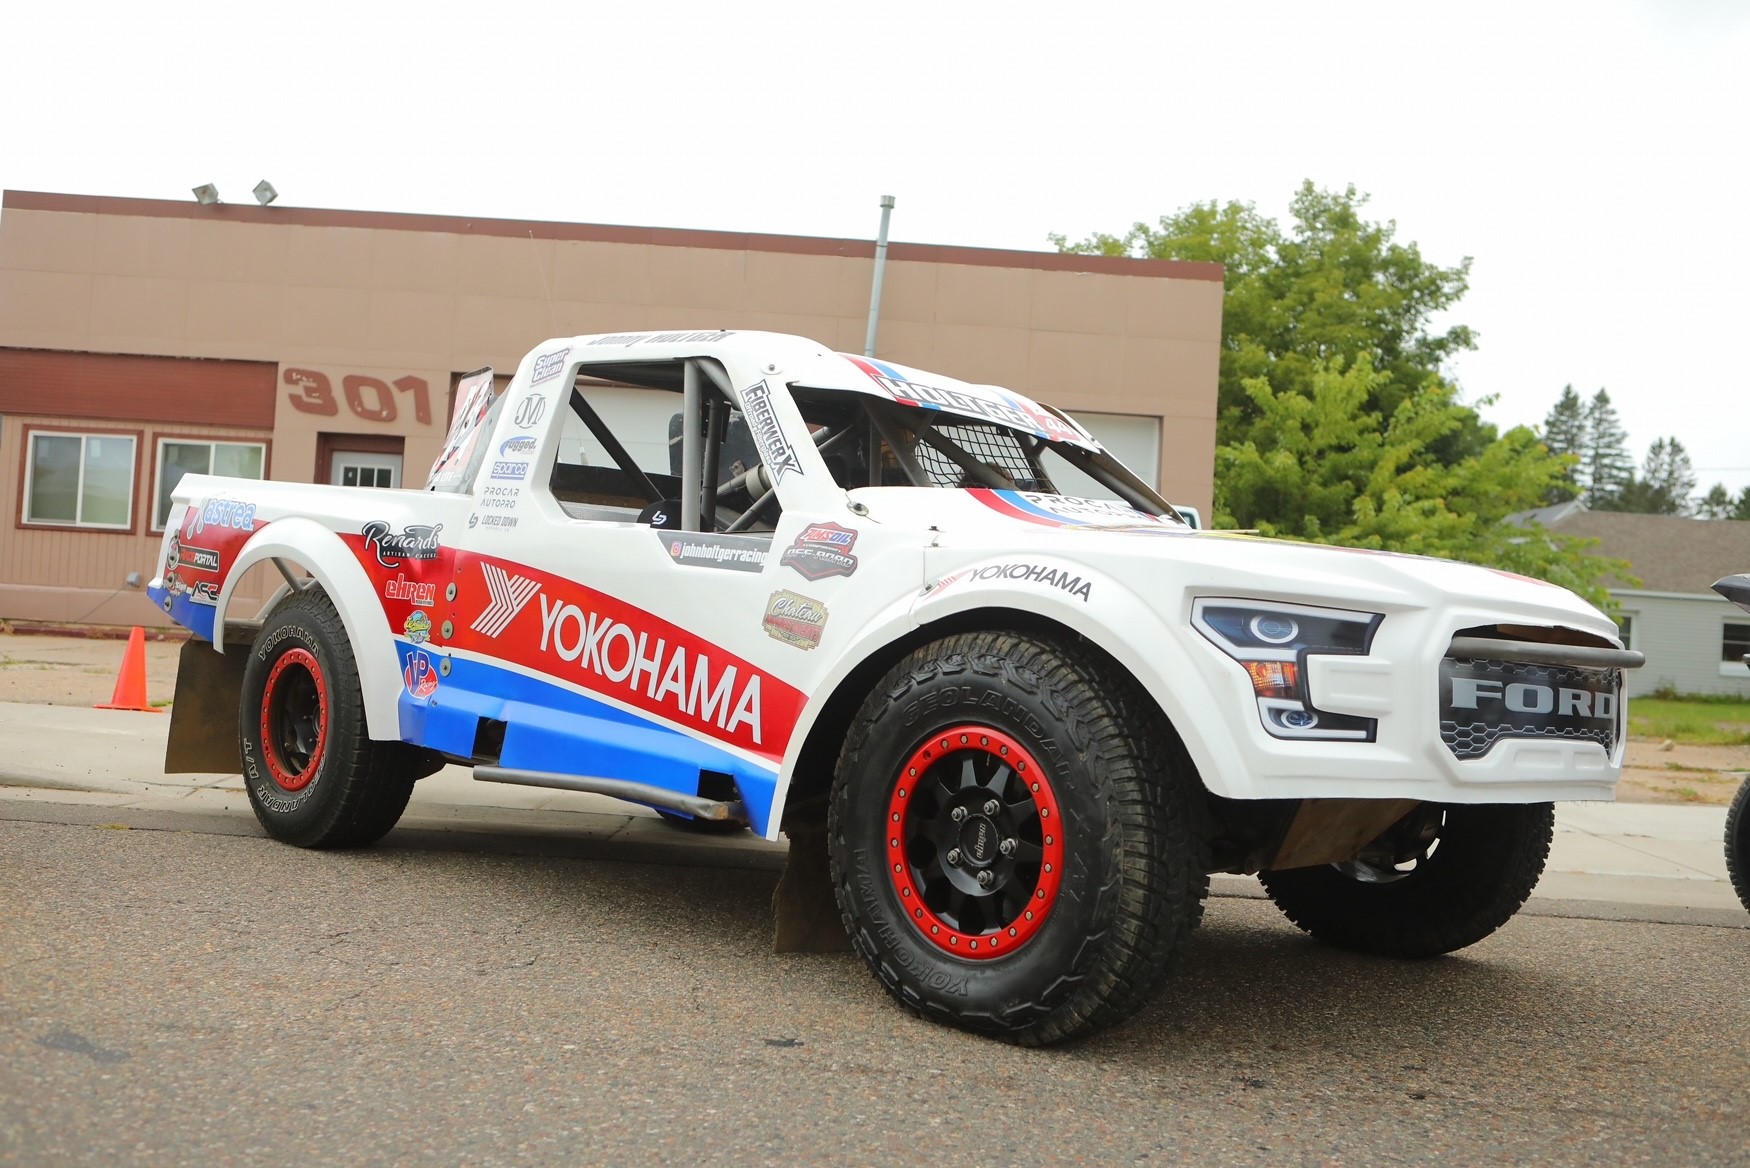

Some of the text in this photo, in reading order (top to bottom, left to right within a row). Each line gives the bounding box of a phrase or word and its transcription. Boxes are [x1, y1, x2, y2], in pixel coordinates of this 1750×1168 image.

[532, 362, 564, 383] Clean
[534, 349, 570, 372] Super
[282, 367, 432, 426] 301
[873, 375, 1044, 433] HOLTGER
[744, 384, 798, 477] FIBERWERX
[492, 461, 529, 479] sparco
[480, 498, 516, 509] AUTOPRO
[484, 486, 520, 497] PROCAR
[481, 514, 519, 528] LOCKED DOWN
[800, 527, 854, 546] AMSOIL
[382, 550, 411, 558] ARTISAN
[680, 542, 769, 567] johnholtgerracing
[968, 563, 1092, 603] YOKOHAMA
[772, 597, 823, 624] Chateau
[258, 625, 321, 662] YOKOHAMA
[405, 650, 430, 696] VP
[539, 592, 762, 745] YOKOHAMA
[1450, 677, 1616, 720] FORD
[853, 848, 970, 999] YOKOHAMA
